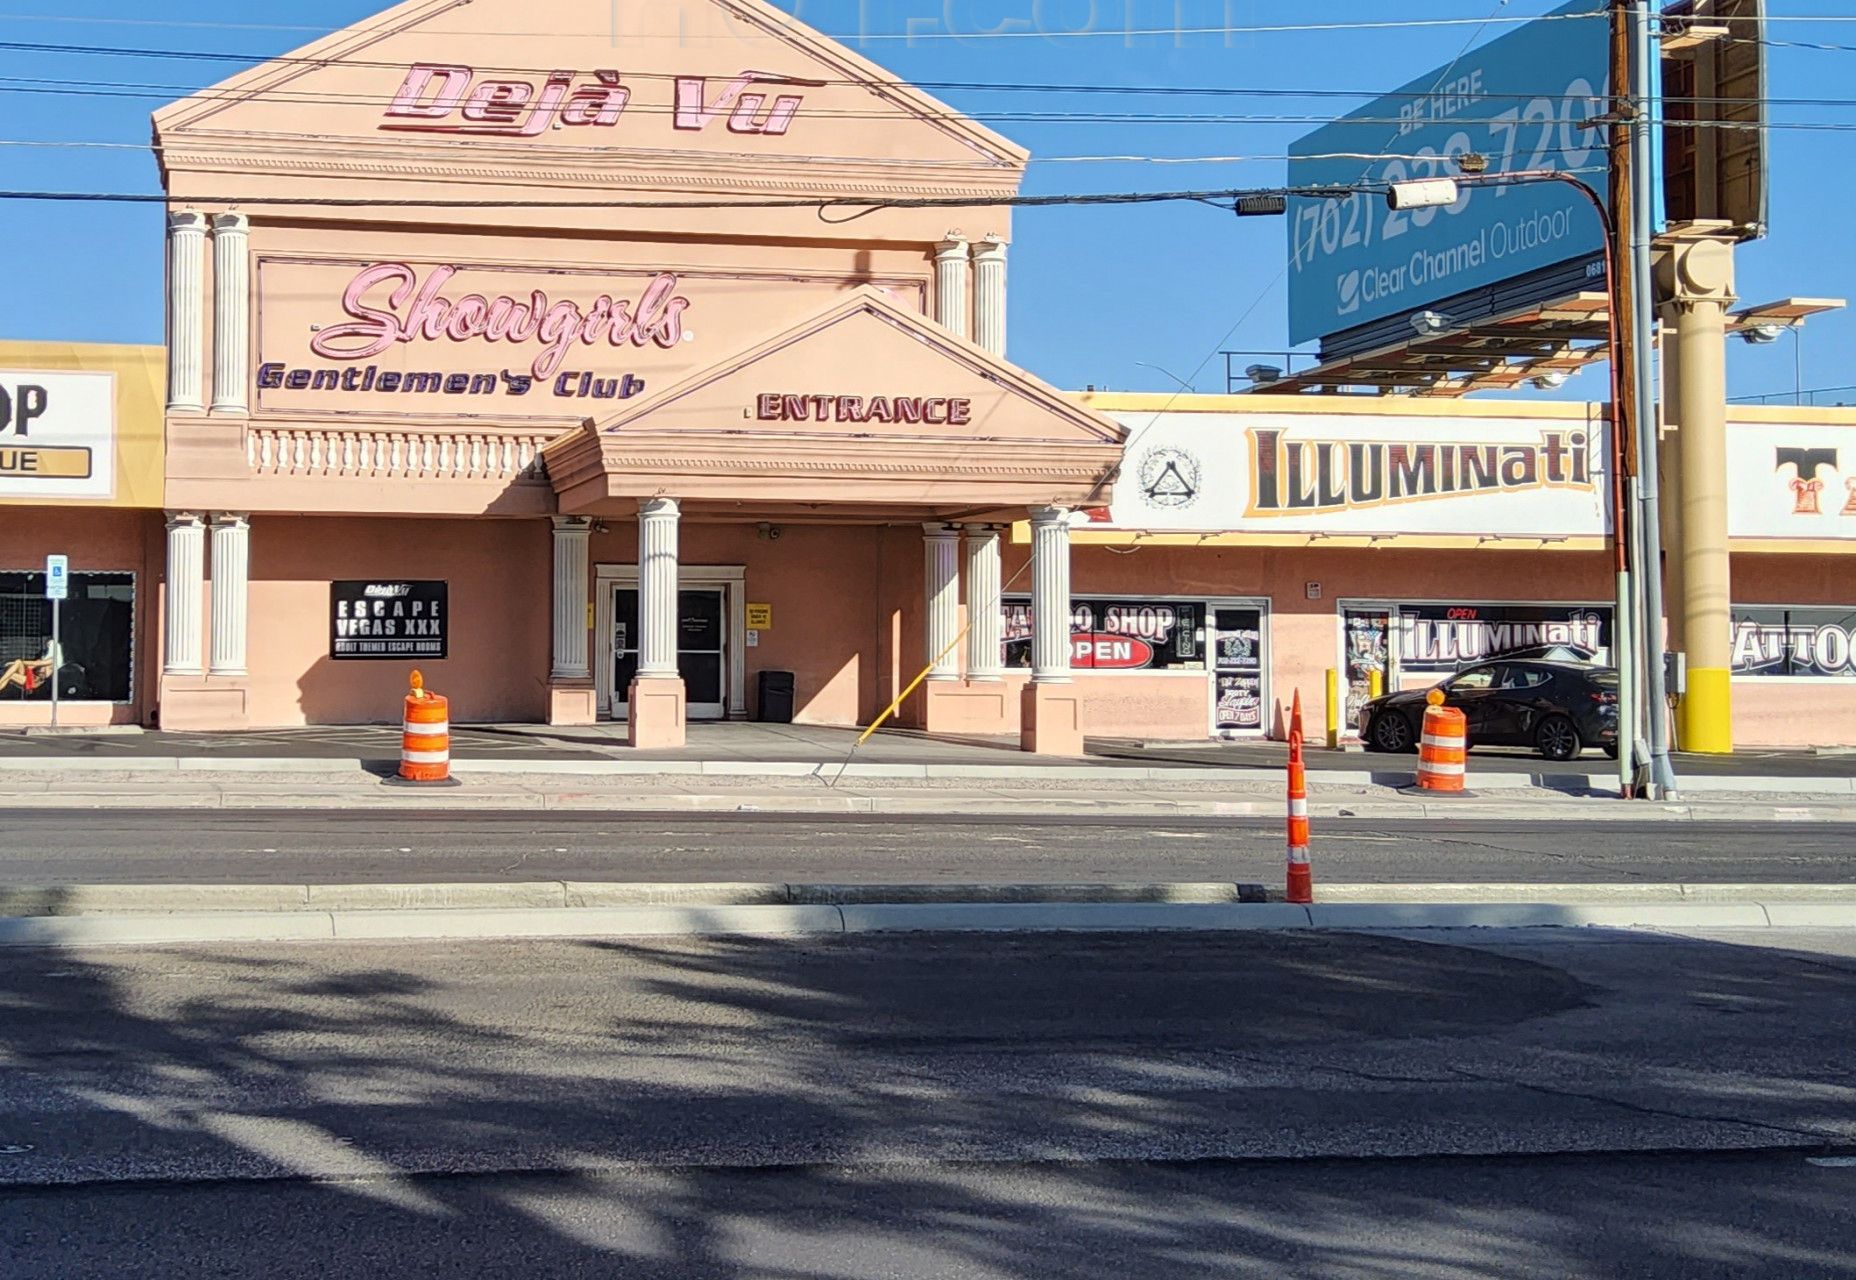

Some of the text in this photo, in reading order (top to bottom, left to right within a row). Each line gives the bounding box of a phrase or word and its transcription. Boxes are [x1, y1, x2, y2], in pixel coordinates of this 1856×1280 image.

[672, 69, 826, 136] Vu
[1399, 96, 1428, 136] BE
[1487, 66, 1610, 198] 720
[1361, 204, 1574, 303] Clear Channel Outdoor
[310, 261, 689, 382] Showgirls
[255, 361, 647, 400] Gentlemen's Club
[756, 392, 972, 425] ENTRANCE
[1774, 446, 1856, 516] T
[336, 619, 441, 636] VEGAS XXX
[337, 600, 440, 617] ESCAPE
[1106, 605, 1174, 641] SHOP
[1446, 608, 1477, 620] OPEN
[1730, 616, 1856, 672] ATTO
